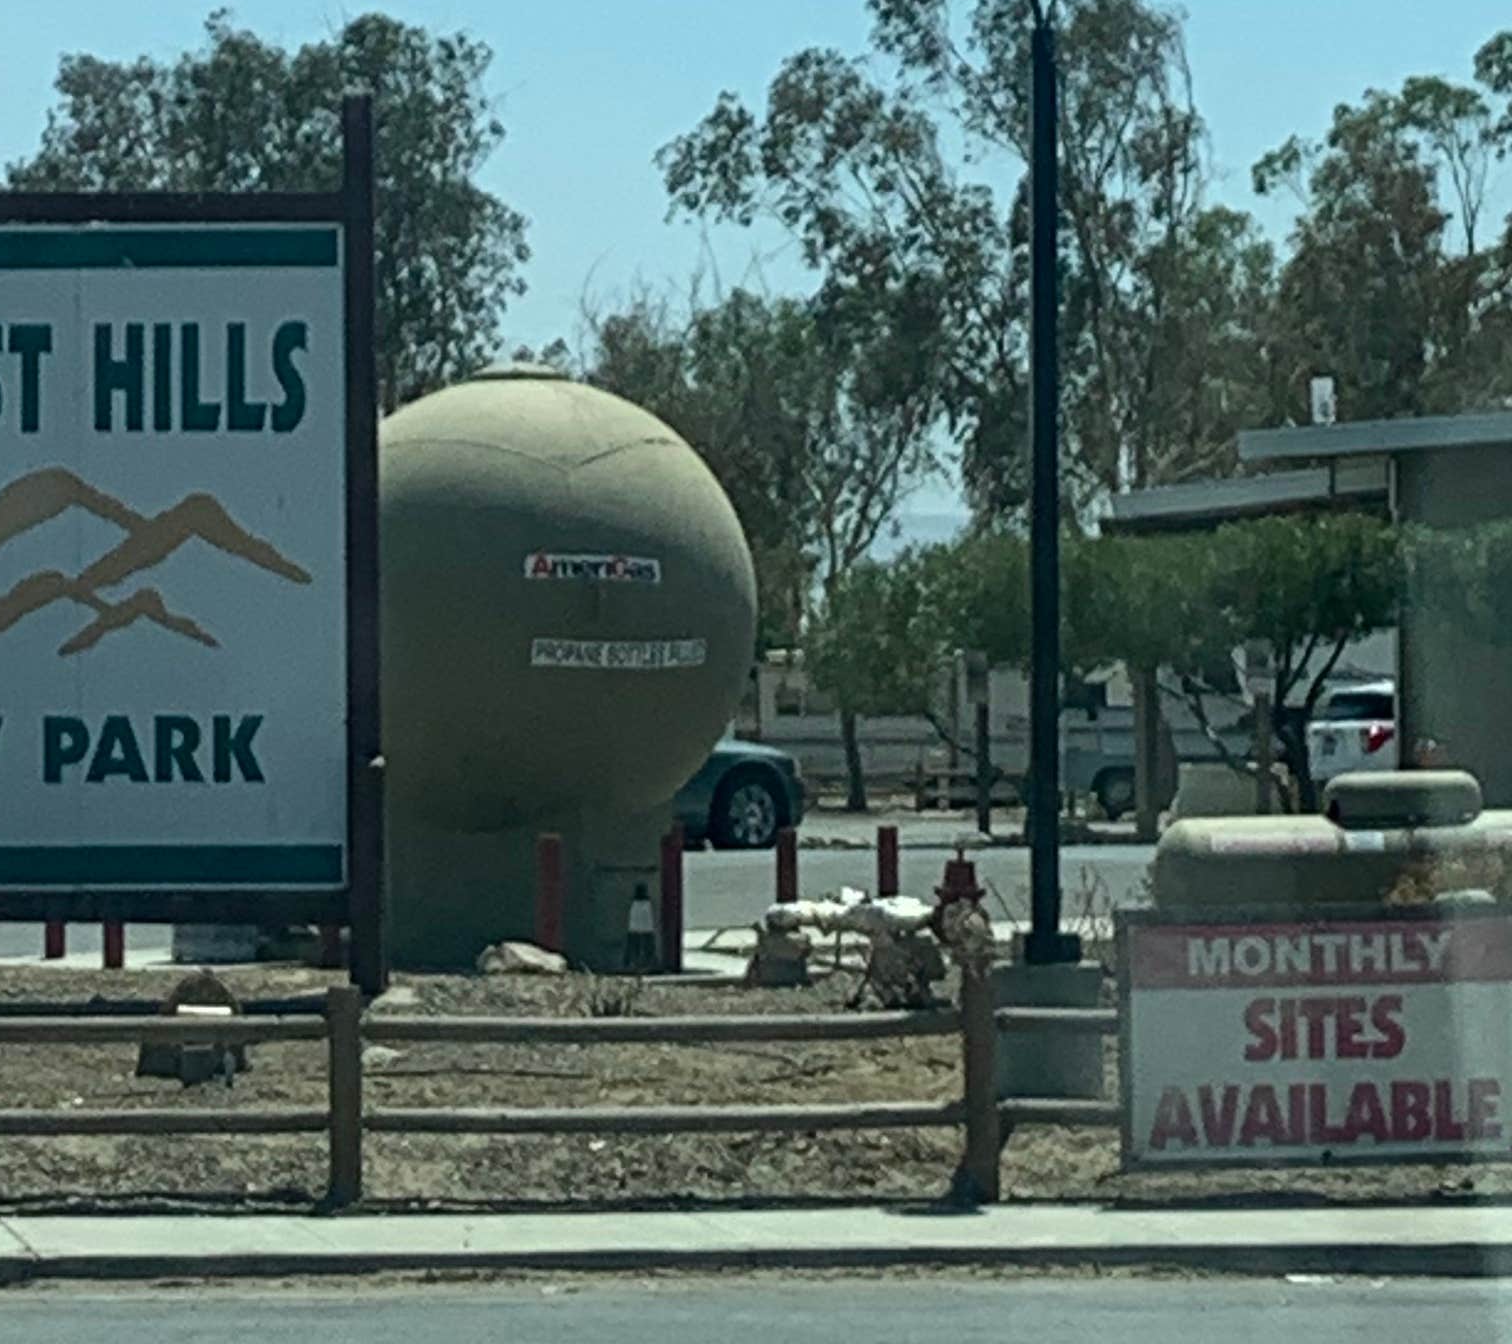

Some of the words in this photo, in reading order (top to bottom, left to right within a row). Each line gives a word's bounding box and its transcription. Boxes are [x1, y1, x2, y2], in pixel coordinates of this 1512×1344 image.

[93, 320, 310, 433] HILLS
[42, 714, 266, 784] PARK
[1190, 932, 1452, 975] MONTHLY
[1243, 994, 1406, 1062] SITES
[1149, 1080, 1502, 1149] AVAILABLE
